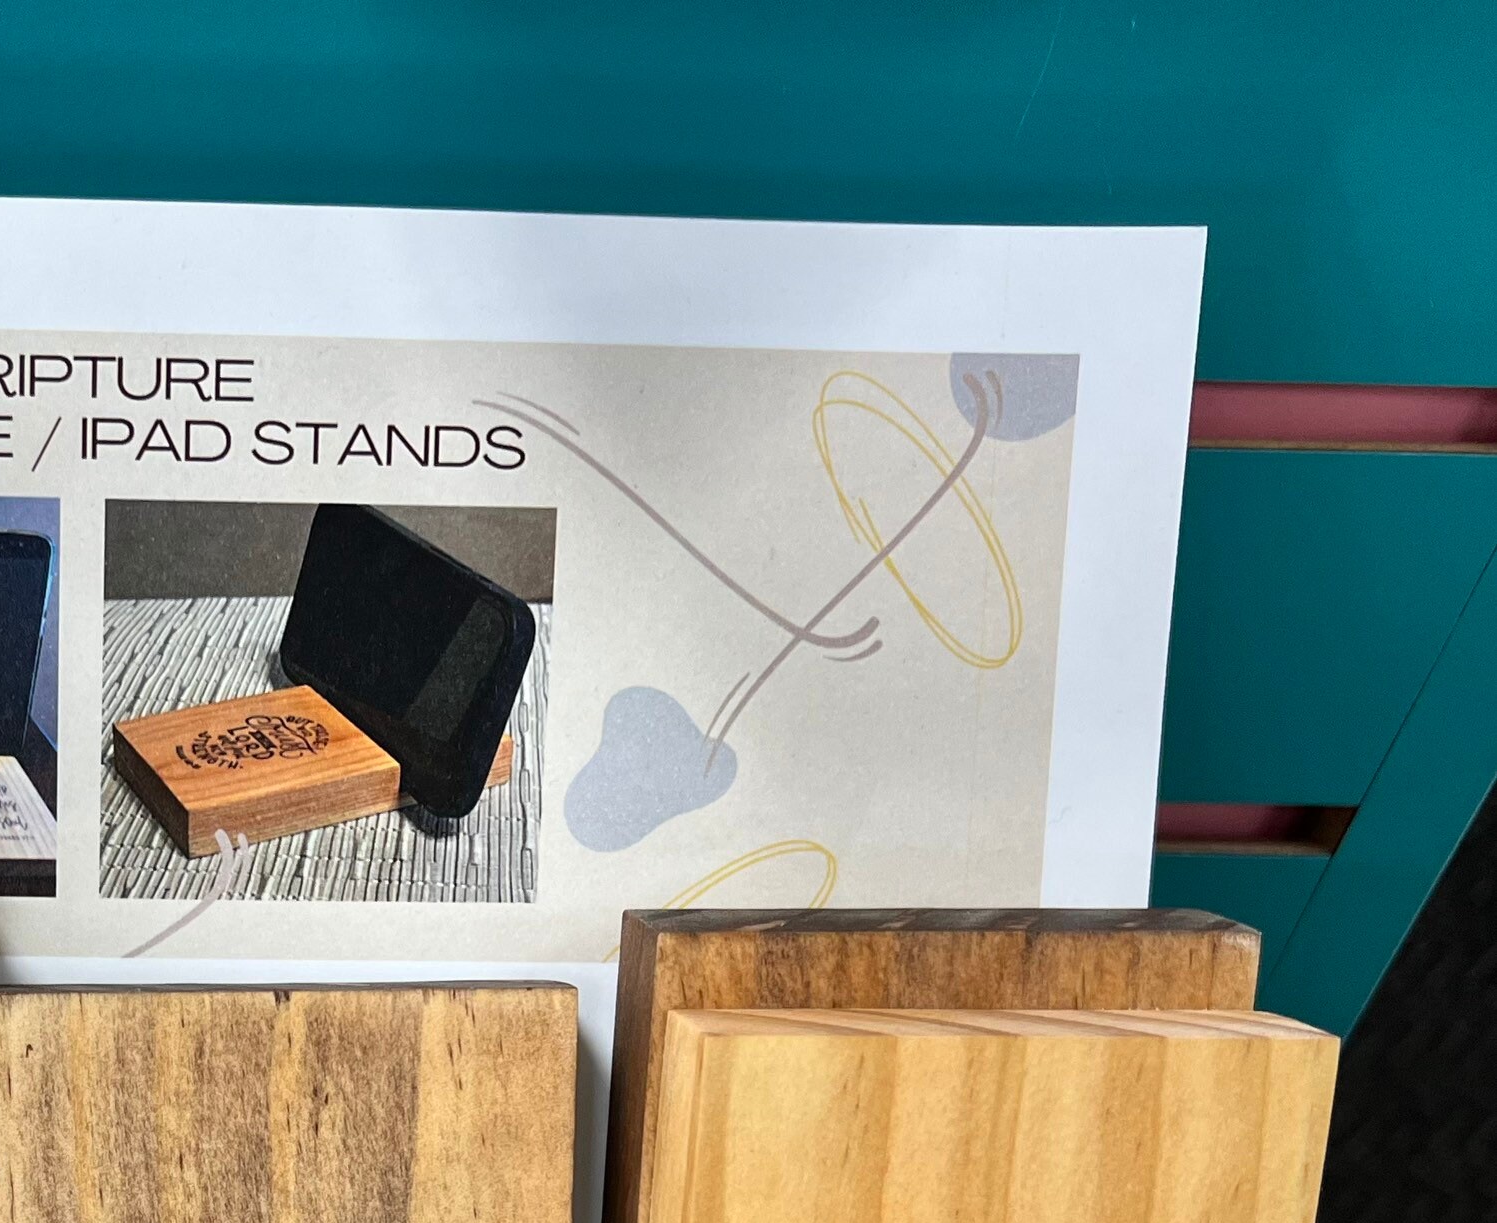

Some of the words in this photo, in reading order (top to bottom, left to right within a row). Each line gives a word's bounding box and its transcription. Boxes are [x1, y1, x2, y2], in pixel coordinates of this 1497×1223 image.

[31, 416, 62, 473] /
[81, 416, 232, 463] IPAD
[251, 419, 526, 470] STANDS
